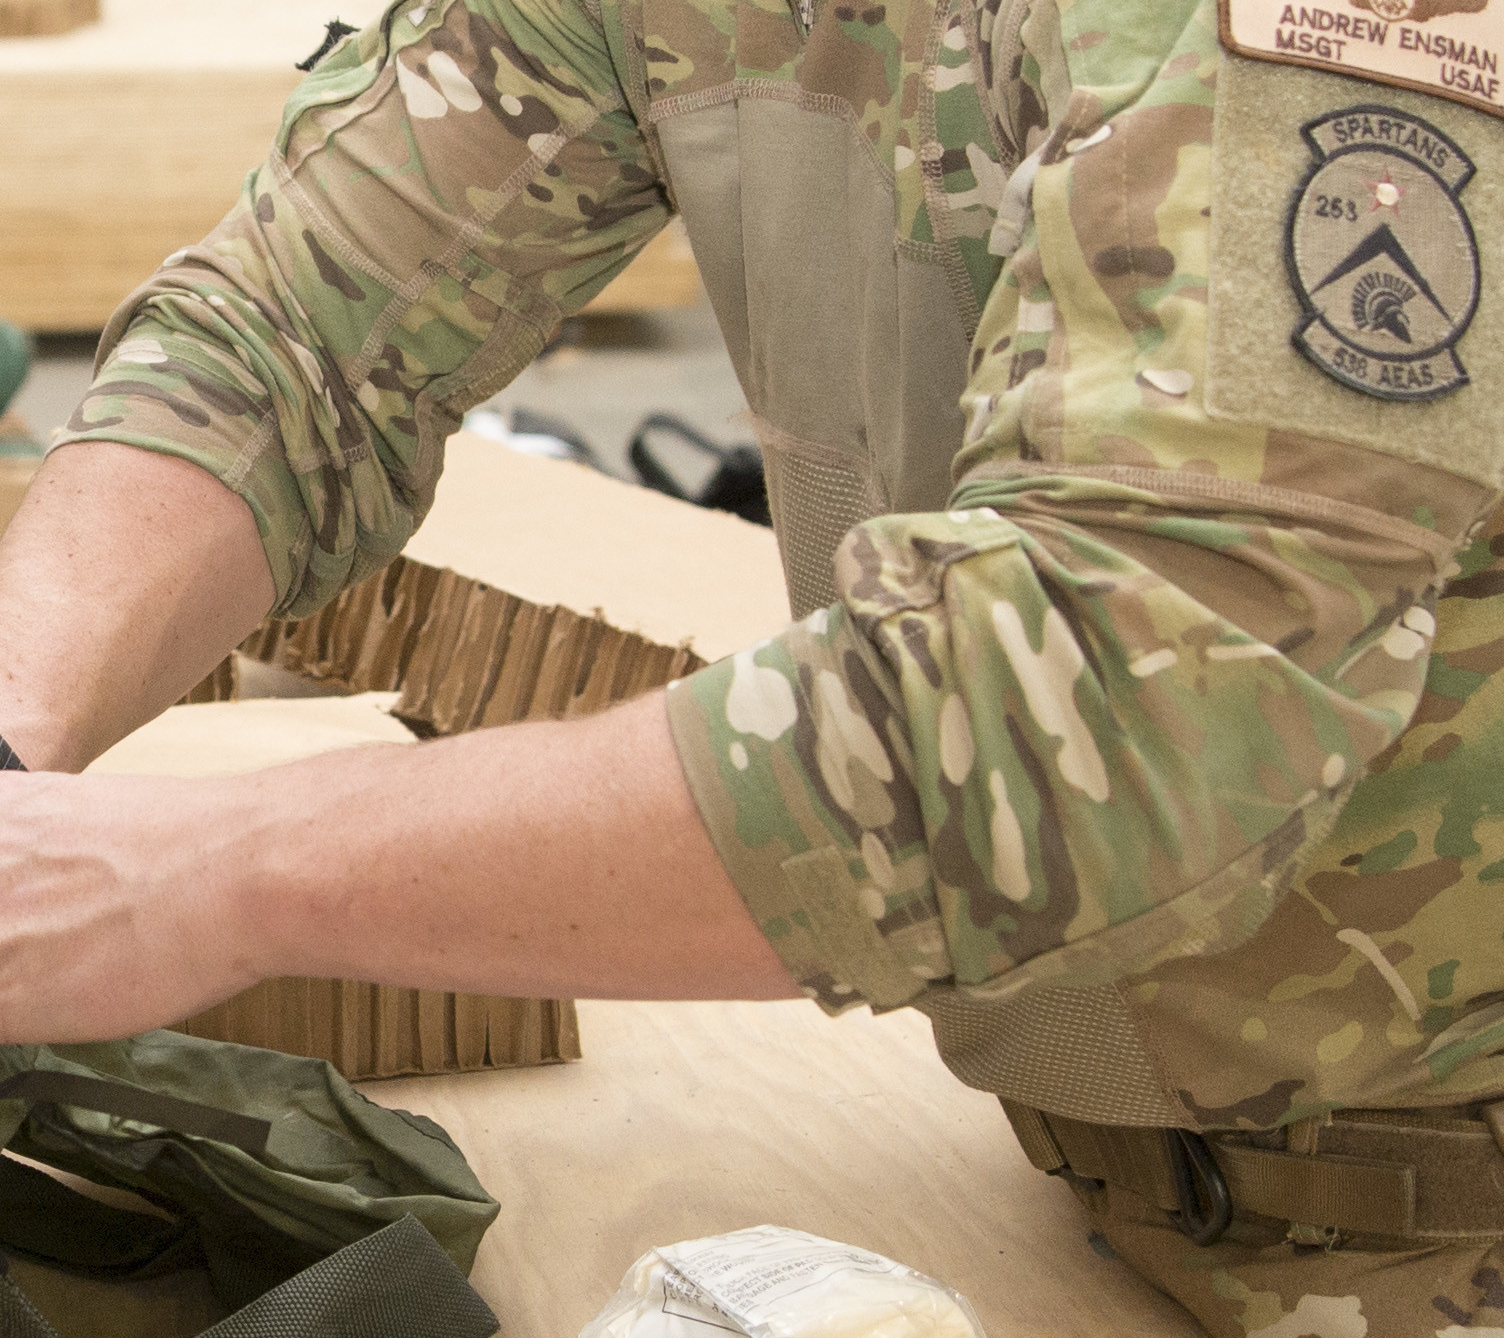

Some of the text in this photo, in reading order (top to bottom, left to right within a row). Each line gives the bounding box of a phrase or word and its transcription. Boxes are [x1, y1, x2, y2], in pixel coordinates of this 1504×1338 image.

[1275, 28, 1347, 60] MSGT
[1279, 4, 1498, 74] ANDREW ENSMAN
[1440, 63, 1500, 99] USAF
[1332, 115, 1449, 169] SPARTANS
